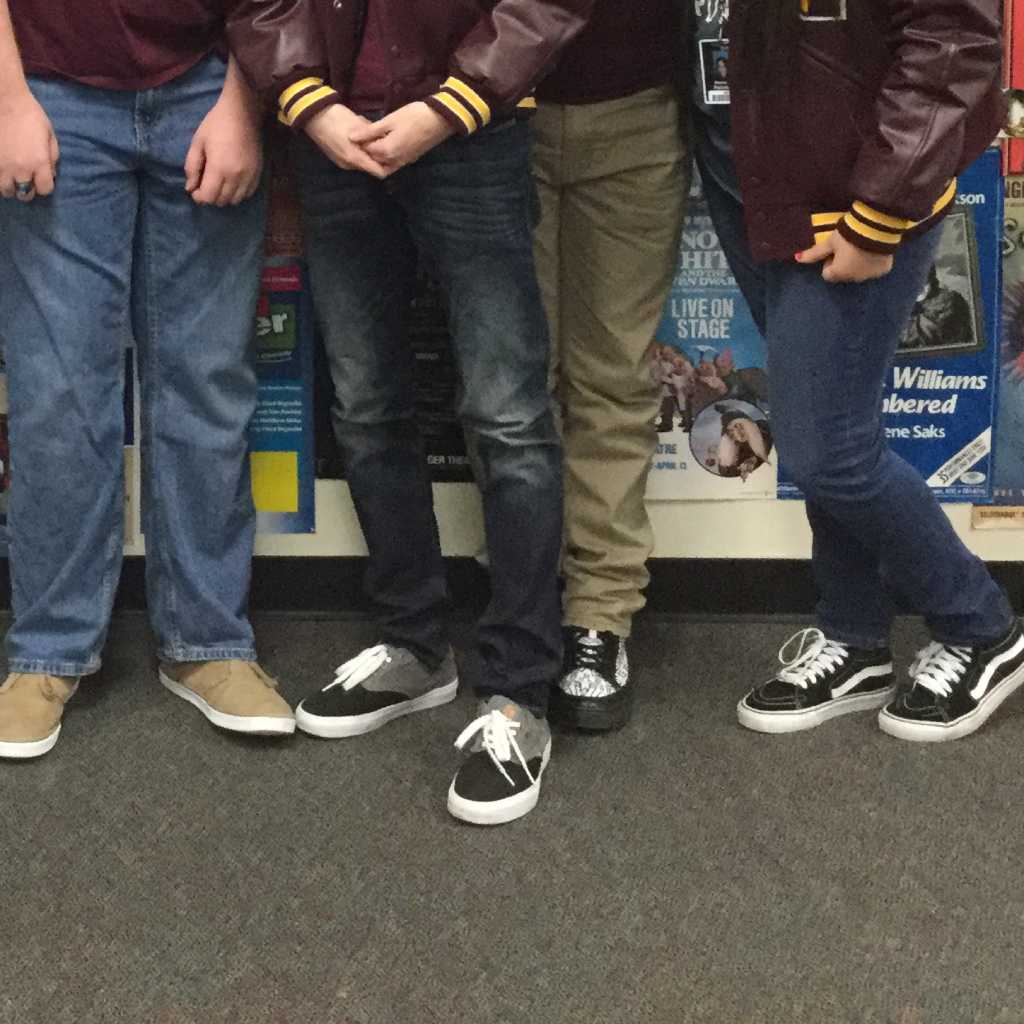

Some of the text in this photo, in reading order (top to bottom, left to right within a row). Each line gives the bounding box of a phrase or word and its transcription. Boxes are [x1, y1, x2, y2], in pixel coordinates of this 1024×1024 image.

[955, 193, 986, 205] son
[682, 230, 719, 250] NO
[671, 298, 734, 318] LIVE ON
[677, 319, 731, 339] STAGE
[892, 366, 988, 390] Williams
[885, 424, 946, 439] ene Saks
